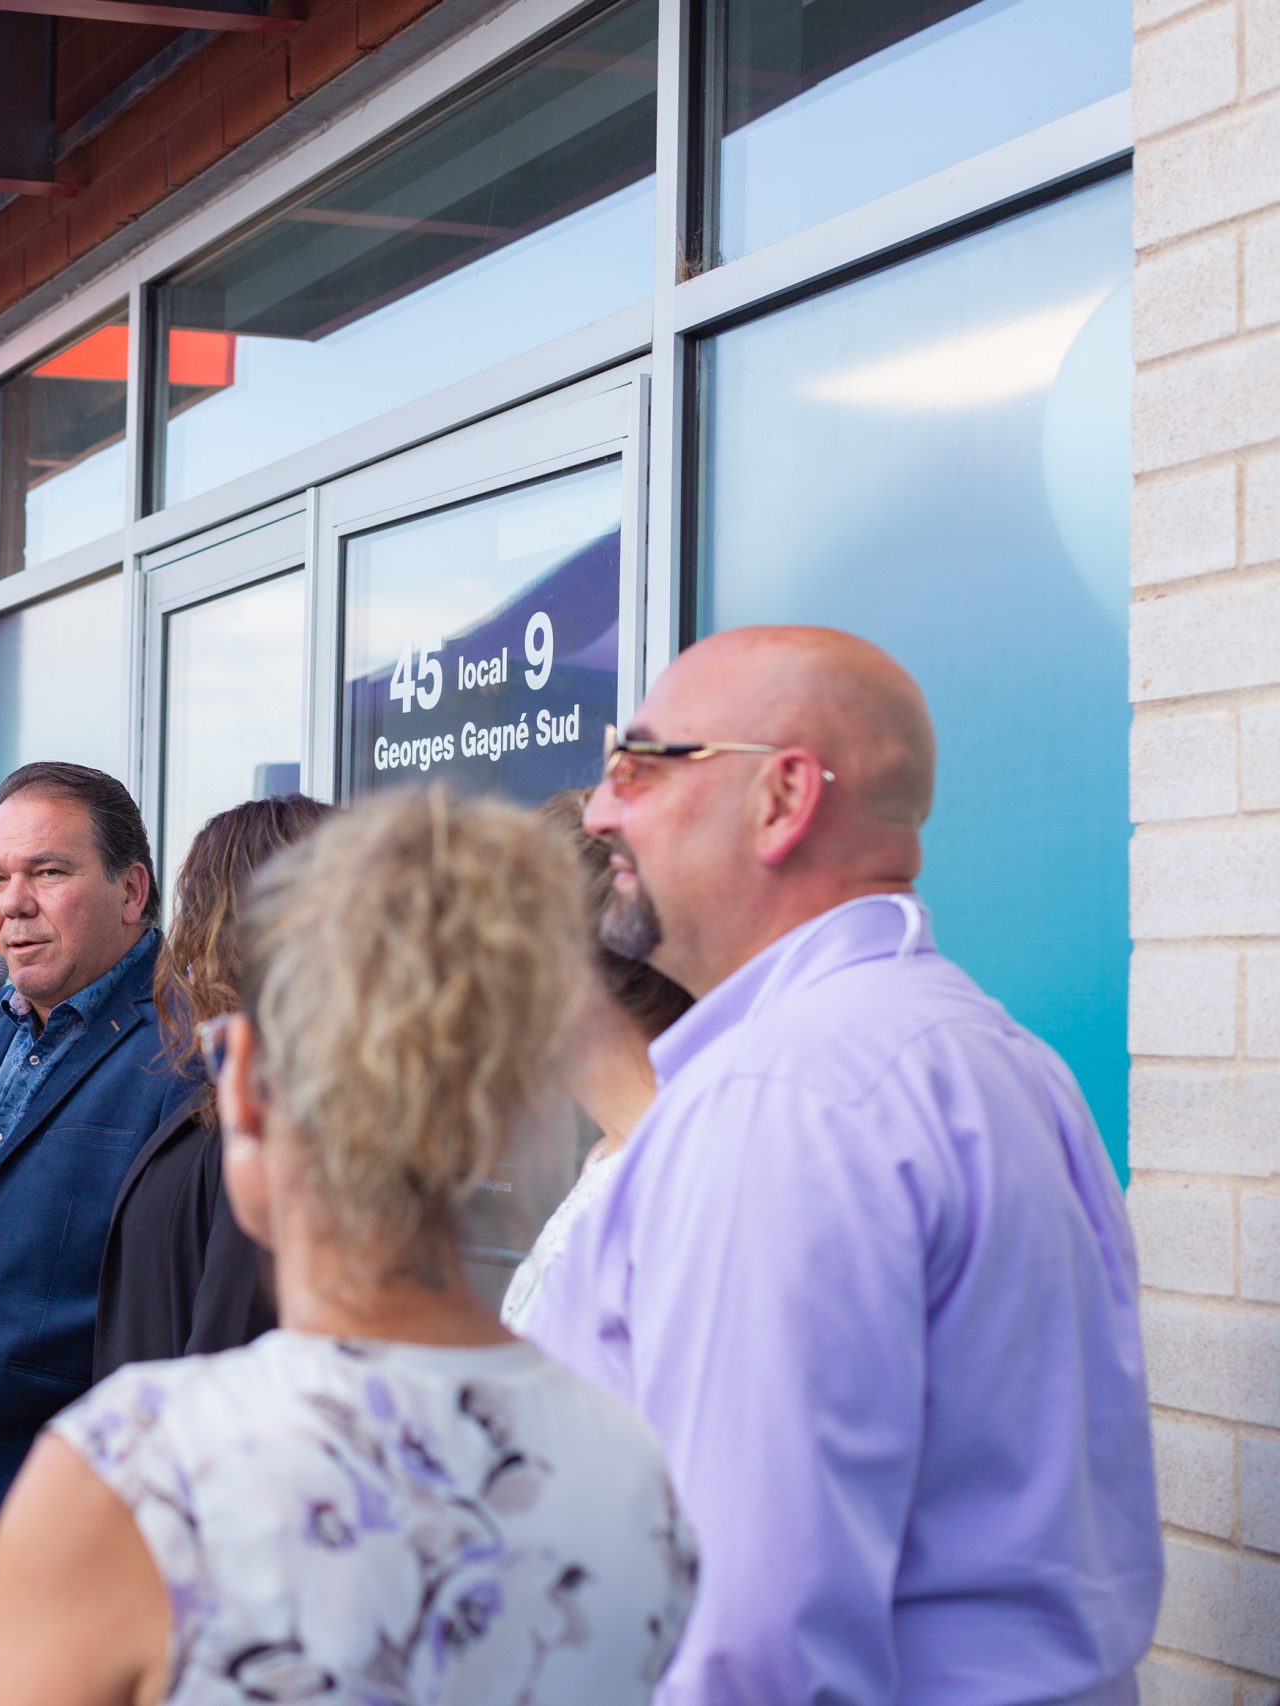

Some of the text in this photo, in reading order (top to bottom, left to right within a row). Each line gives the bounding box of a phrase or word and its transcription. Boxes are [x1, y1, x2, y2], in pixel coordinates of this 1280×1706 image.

[389, 611, 554, 713] 45 local 9
[374, 703, 580, 772] Georges Gagné Sud
